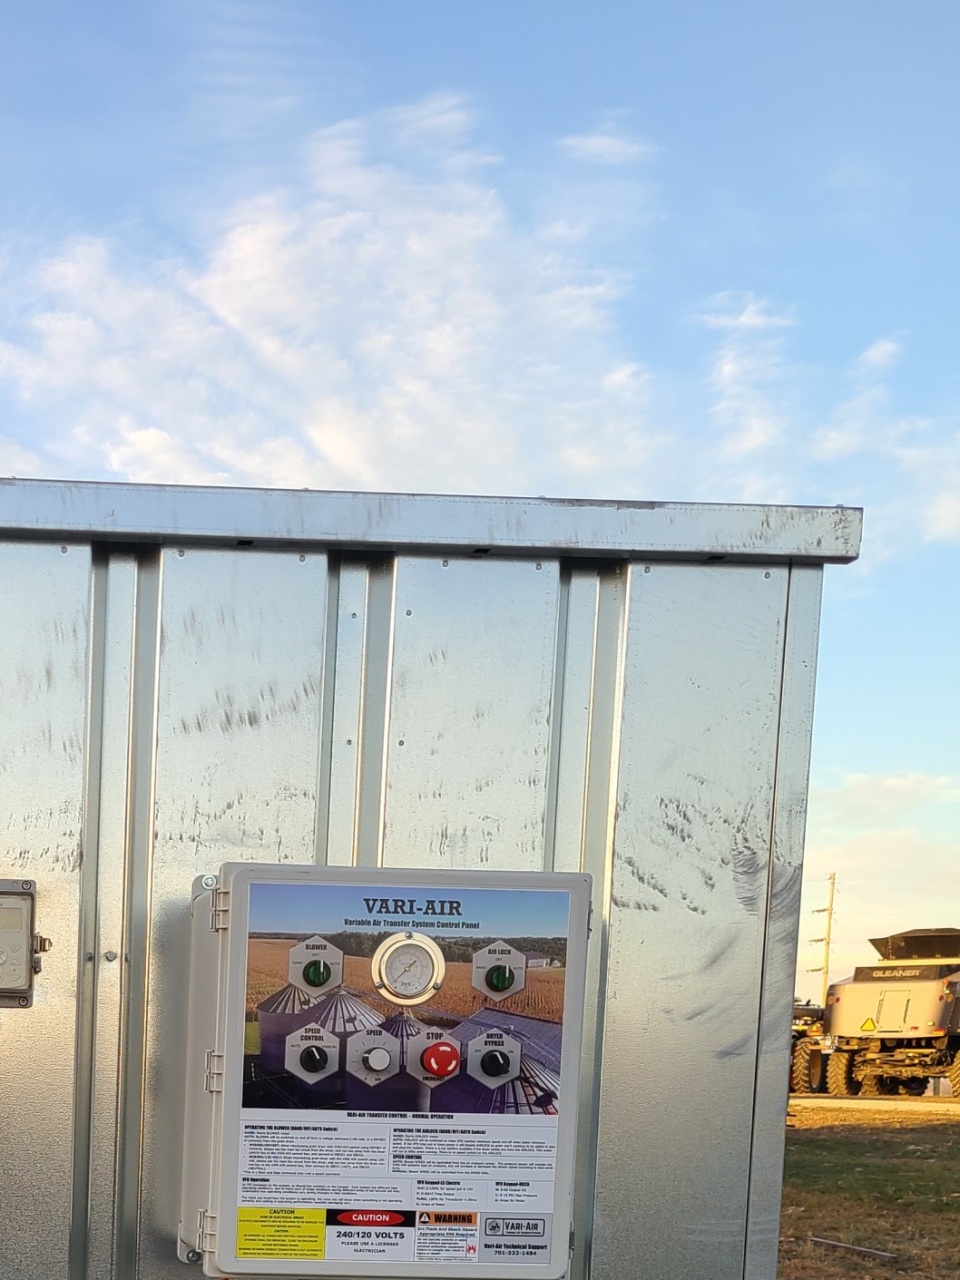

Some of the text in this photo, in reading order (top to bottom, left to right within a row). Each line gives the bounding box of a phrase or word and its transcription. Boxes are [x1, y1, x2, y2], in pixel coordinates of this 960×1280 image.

[363, 898, 462, 916] VARI-AIR
[344, 918, 480, 930] Variable Air Transfer System Control Panel
[426, 1032, 444, 1040] STOP
[351, 1213, 390, 1222] CAUTION
[434, 1213, 473, 1224] WARNING
[505, 1221, 539, 1231] VARI-AIR
[336, 1231, 405, 1240] 240/120 VOLTS
